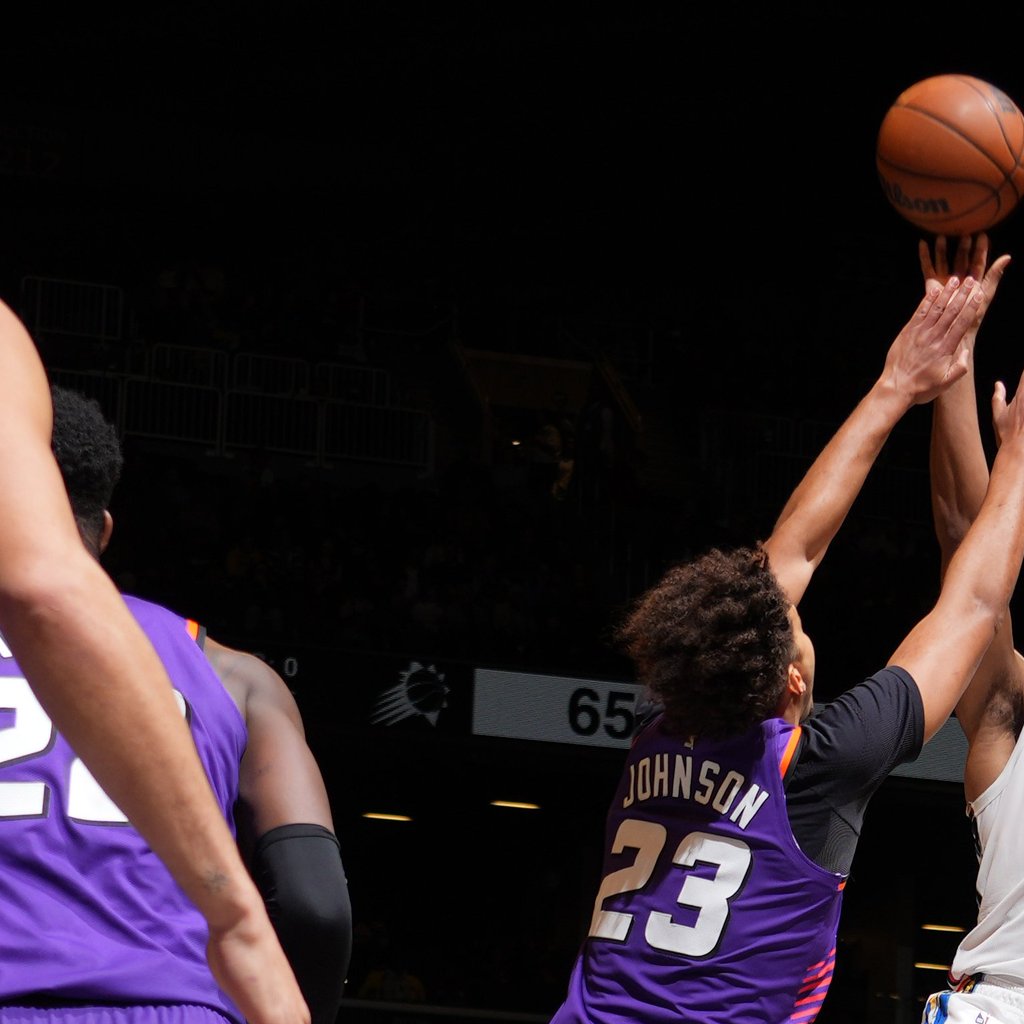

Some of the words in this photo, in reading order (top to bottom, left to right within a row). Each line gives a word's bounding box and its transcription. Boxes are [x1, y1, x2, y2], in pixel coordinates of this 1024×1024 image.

[568, 687, 636, 740] 65
[622, 752, 770, 831] JOHNSON
[587, 817, 754, 958] 23
